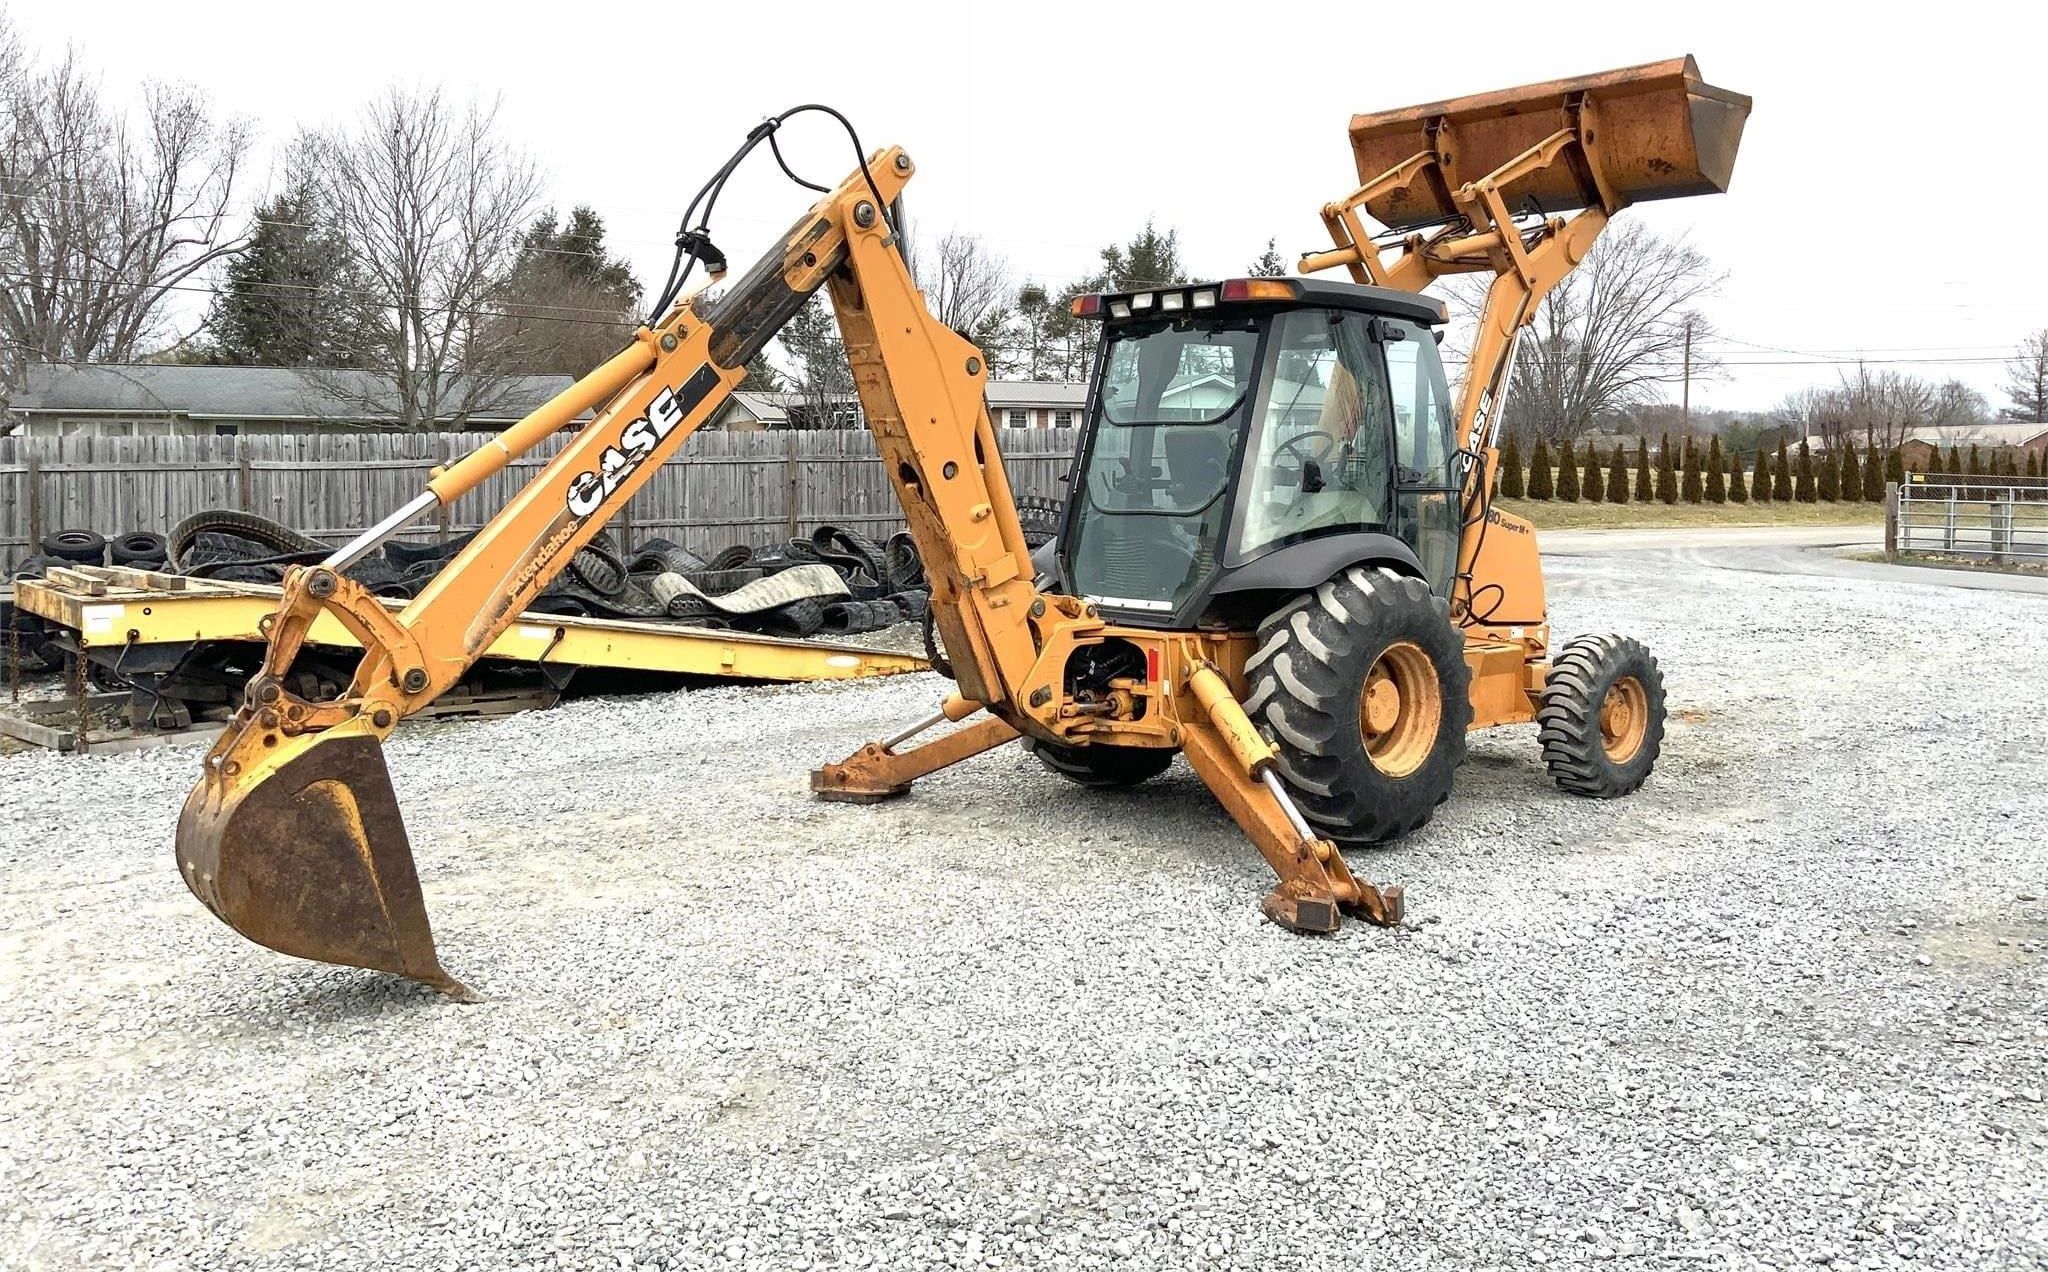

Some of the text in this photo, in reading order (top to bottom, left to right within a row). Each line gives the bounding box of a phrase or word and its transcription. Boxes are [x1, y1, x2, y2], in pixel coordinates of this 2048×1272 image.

[568, 386, 683, 516] CASE
[1462, 388, 1493, 473] CASE
[1500, 518, 1519, 532] Super
